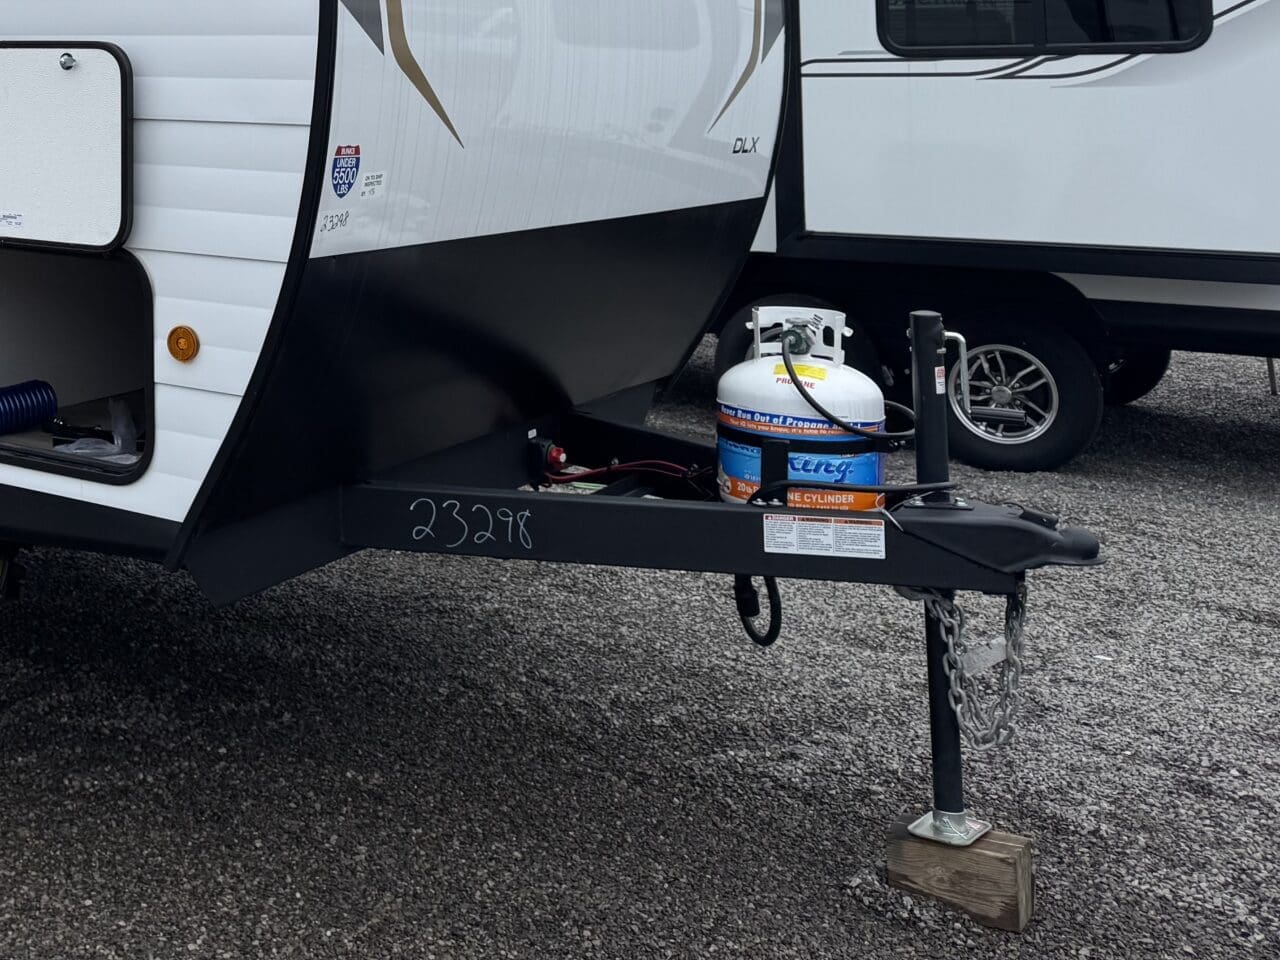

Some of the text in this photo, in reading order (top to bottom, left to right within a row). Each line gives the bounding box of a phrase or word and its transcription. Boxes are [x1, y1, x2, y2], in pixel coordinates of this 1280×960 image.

[732, 136, 760, 154] DLX
[336, 157, 356, 168] UNDER
[333, 168, 357, 184] 5500
[337, 184, 349, 194] LBS
[737, 409, 751, 421] Run
[754, 412, 769, 424] Out
[772, 415, 783, 426] of
[786, 417, 829, 430] Propane
[804, 493, 854, 504] CYLINDER
[409, 497, 533, 550] 23298
